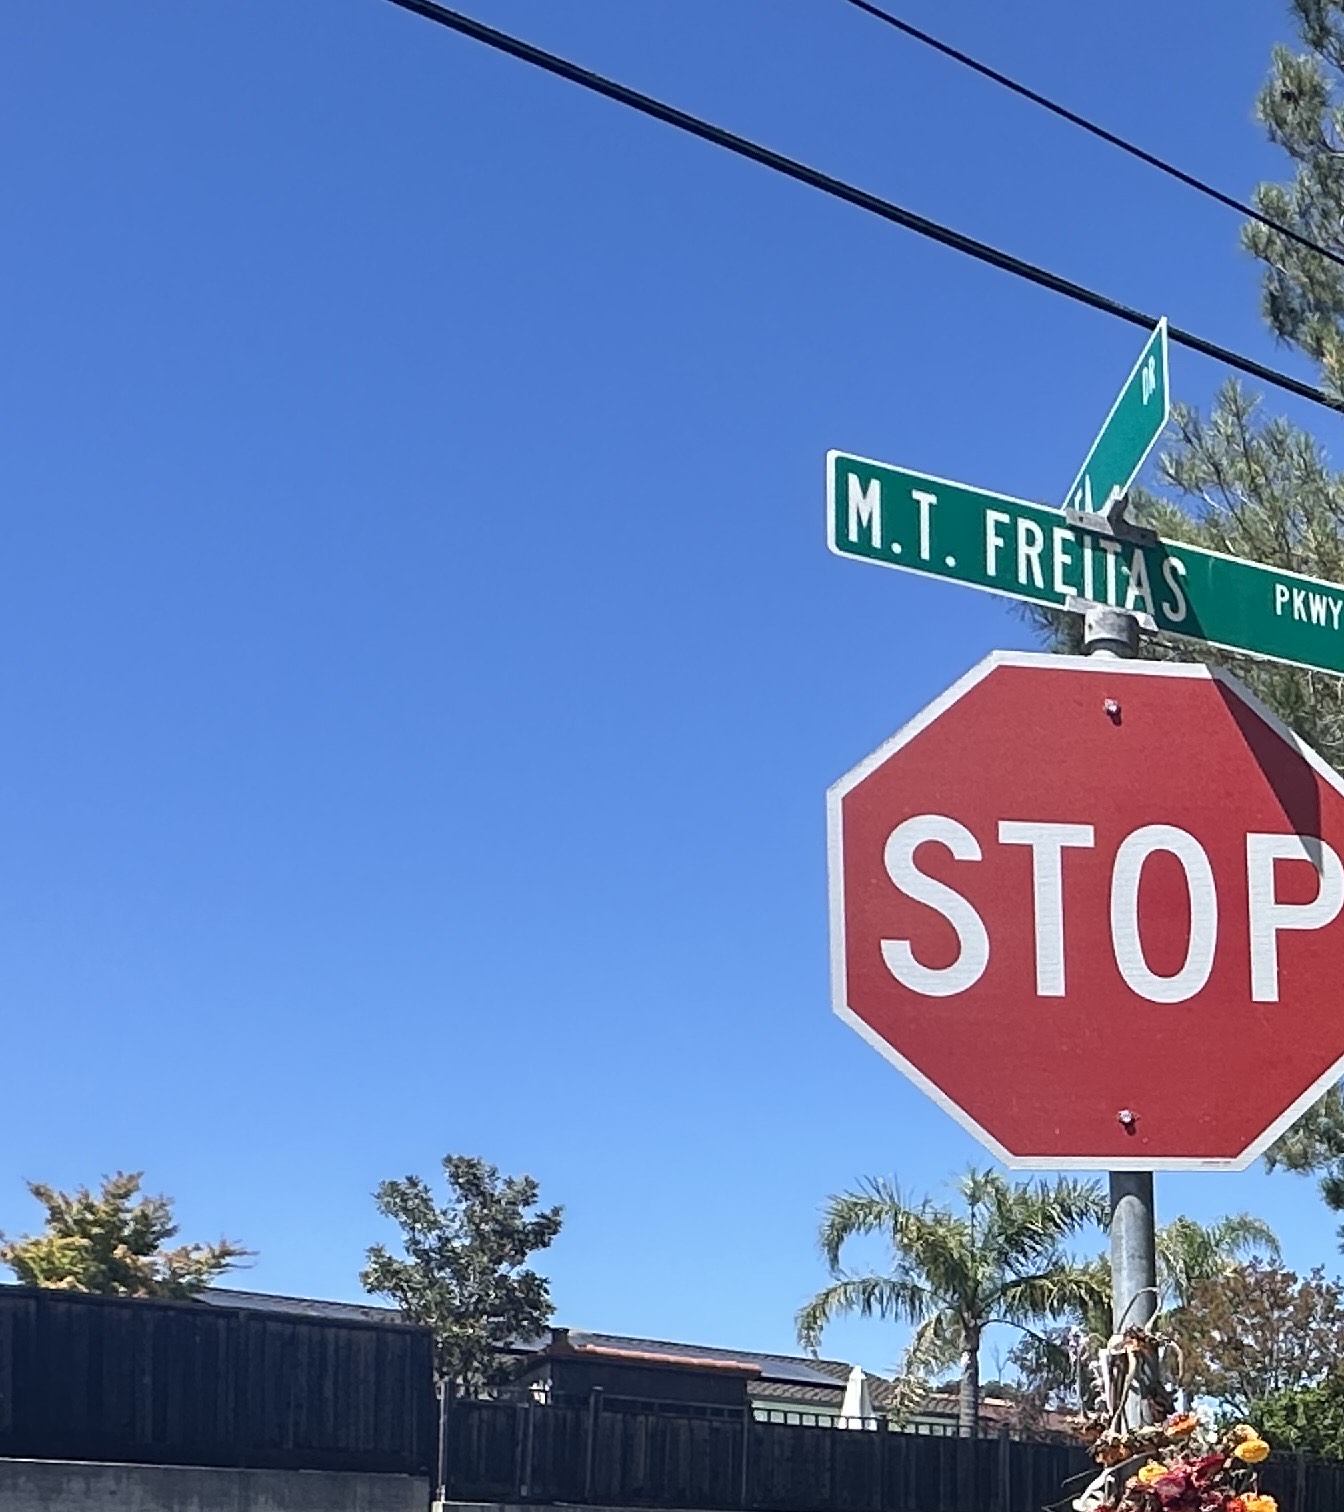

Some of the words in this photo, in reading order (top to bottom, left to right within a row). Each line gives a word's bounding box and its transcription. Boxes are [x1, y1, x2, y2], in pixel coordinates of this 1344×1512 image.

[1141, 354, 1156, 406] DR
[846, 471, 956, 569] M.T.
[985, 509, 1188, 622] FREITAS
[1274, 582, 1344, 631] PKWY
